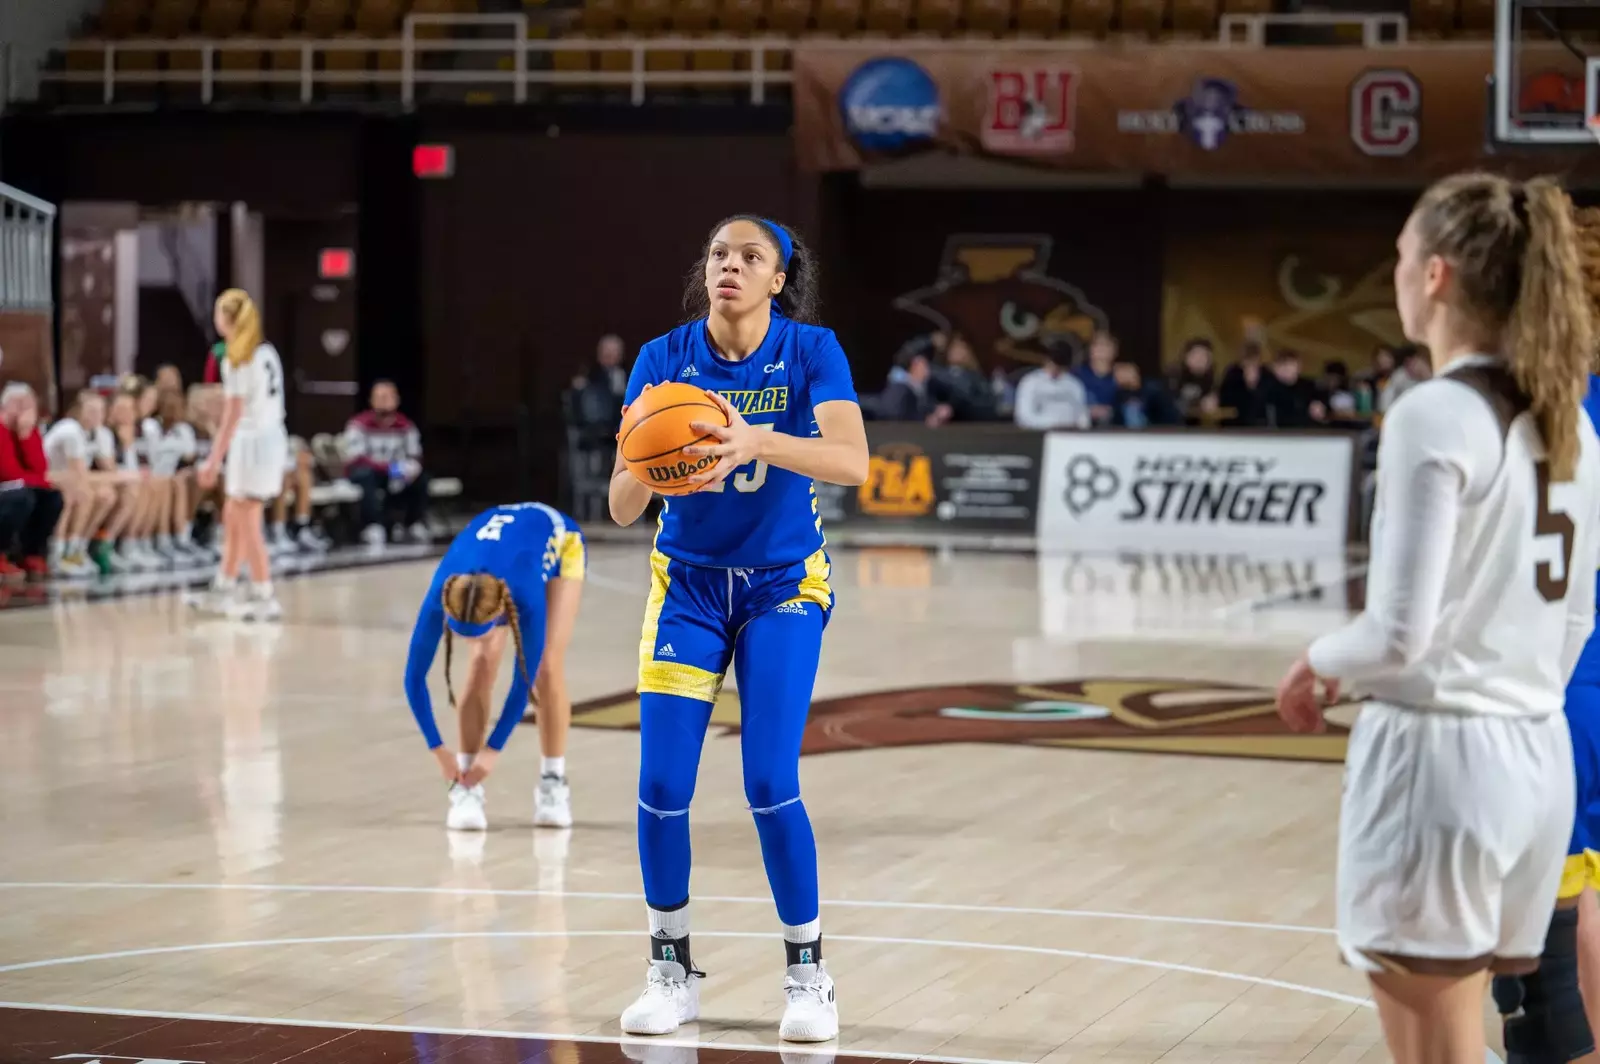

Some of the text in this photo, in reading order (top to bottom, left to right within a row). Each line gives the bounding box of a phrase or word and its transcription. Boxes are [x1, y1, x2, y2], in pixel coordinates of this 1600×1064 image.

[718, 386, 789, 415] WARE
[1135, 455, 1277, 475] HONEY
[1120, 477, 1327, 525] STINGER
[1533, 458, 1576, 606] 5
[776, 606, 809, 616] adidas
